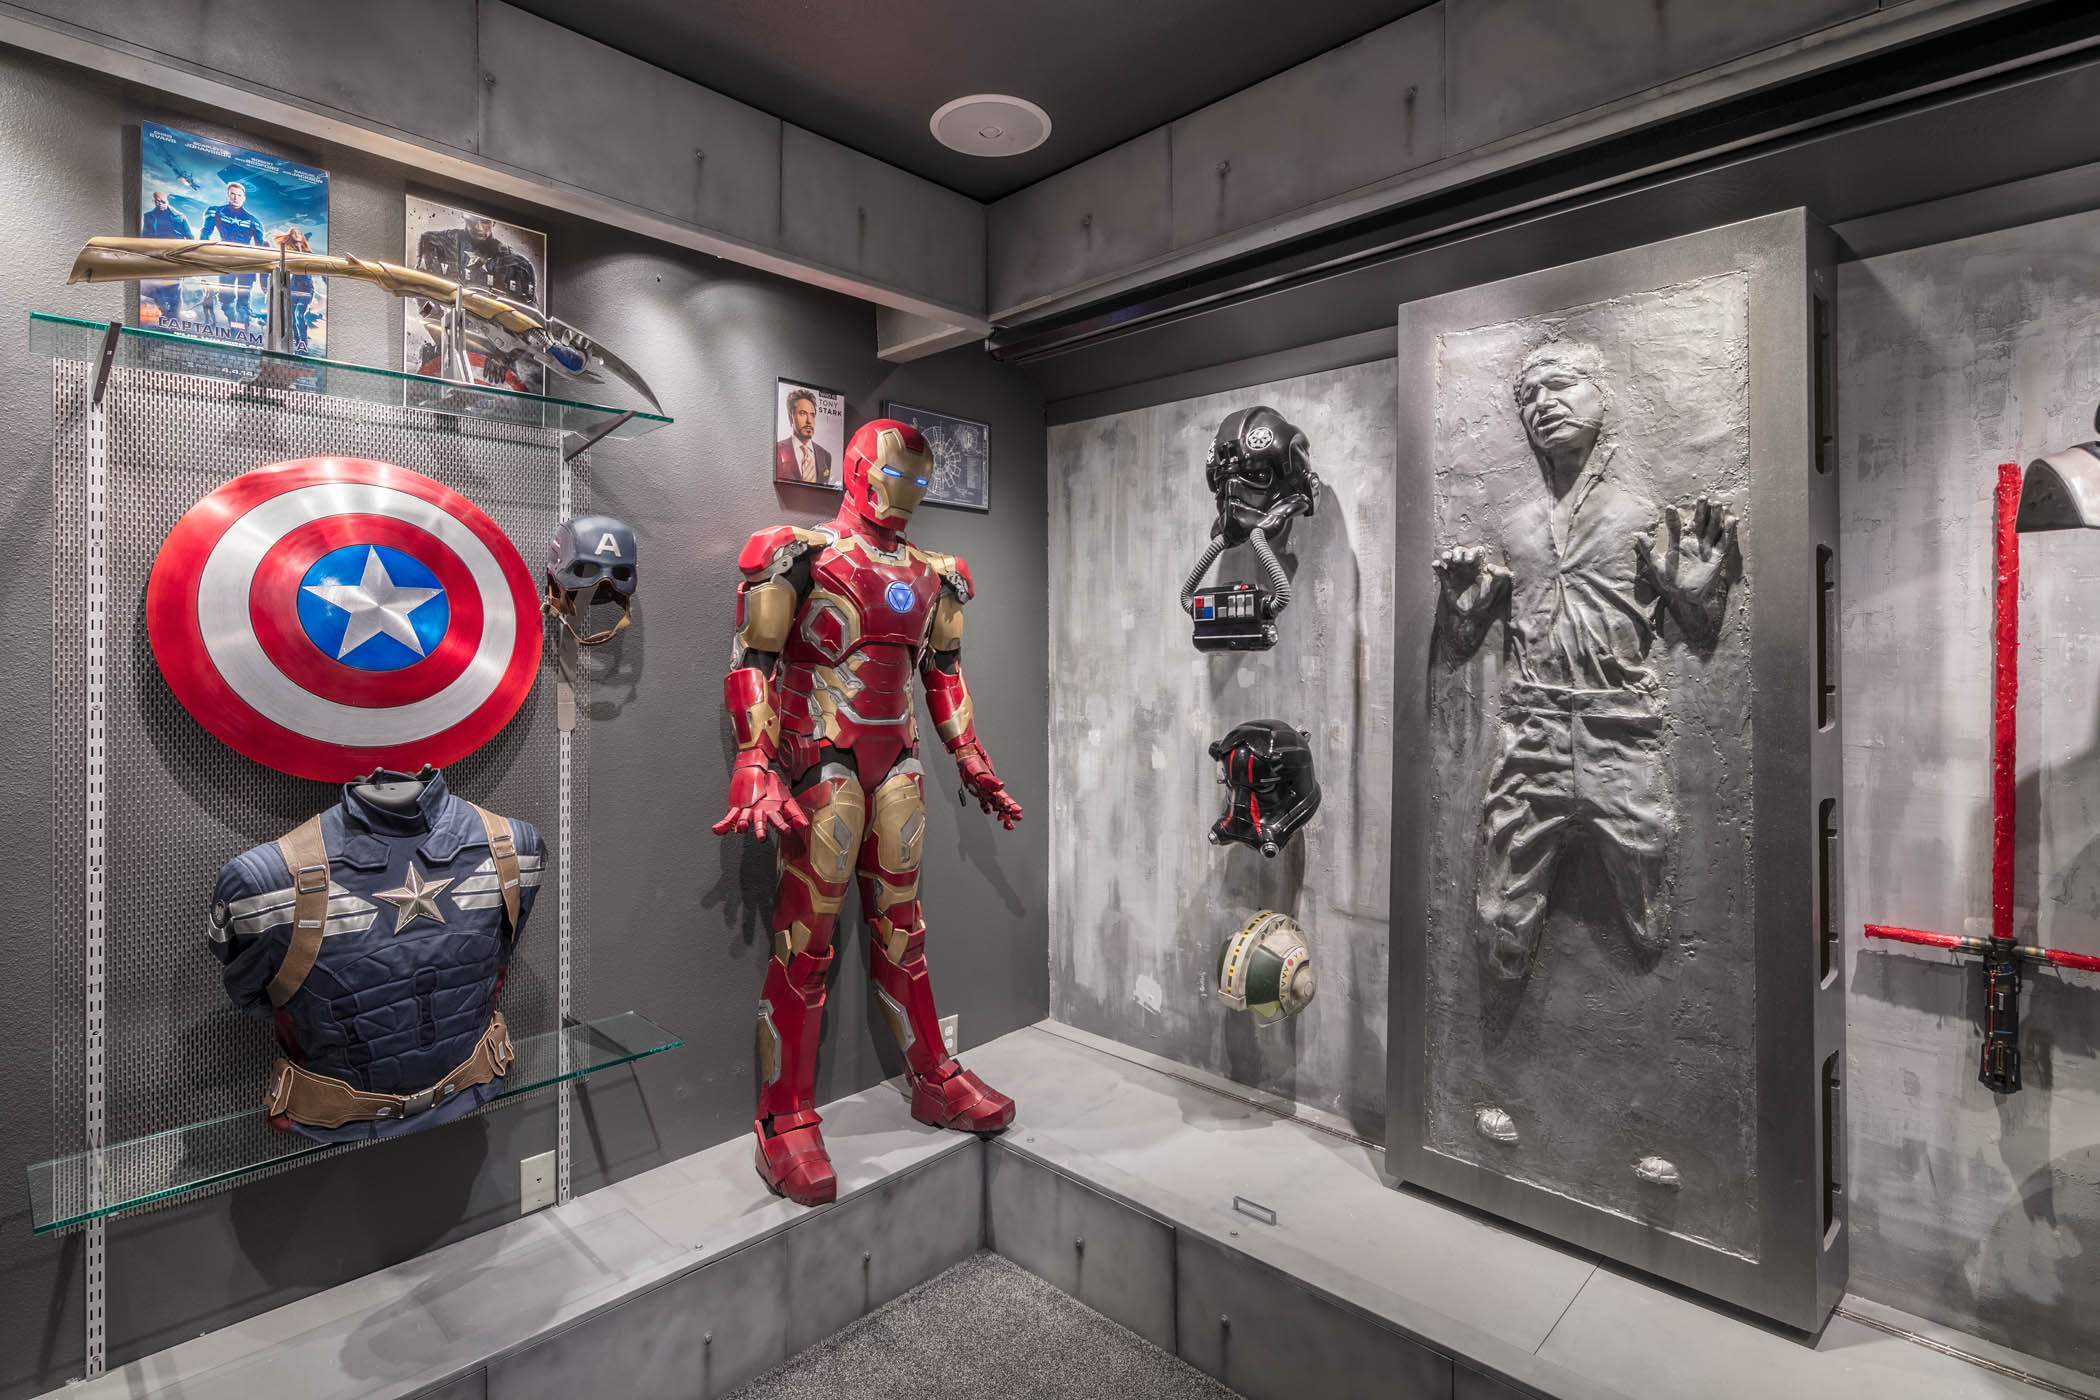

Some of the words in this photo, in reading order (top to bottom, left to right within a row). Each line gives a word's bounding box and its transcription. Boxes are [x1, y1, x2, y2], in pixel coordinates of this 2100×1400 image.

[149, 132, 177, 144] EVANS
[184, 143, 232, 159] JOHANSSON
[158, 316, 231, 339] CAPTAIN
[819, 399, 838, 408] TONY
[819, 407, 842, 416] STARK
[594, 532, 622, 557] A
